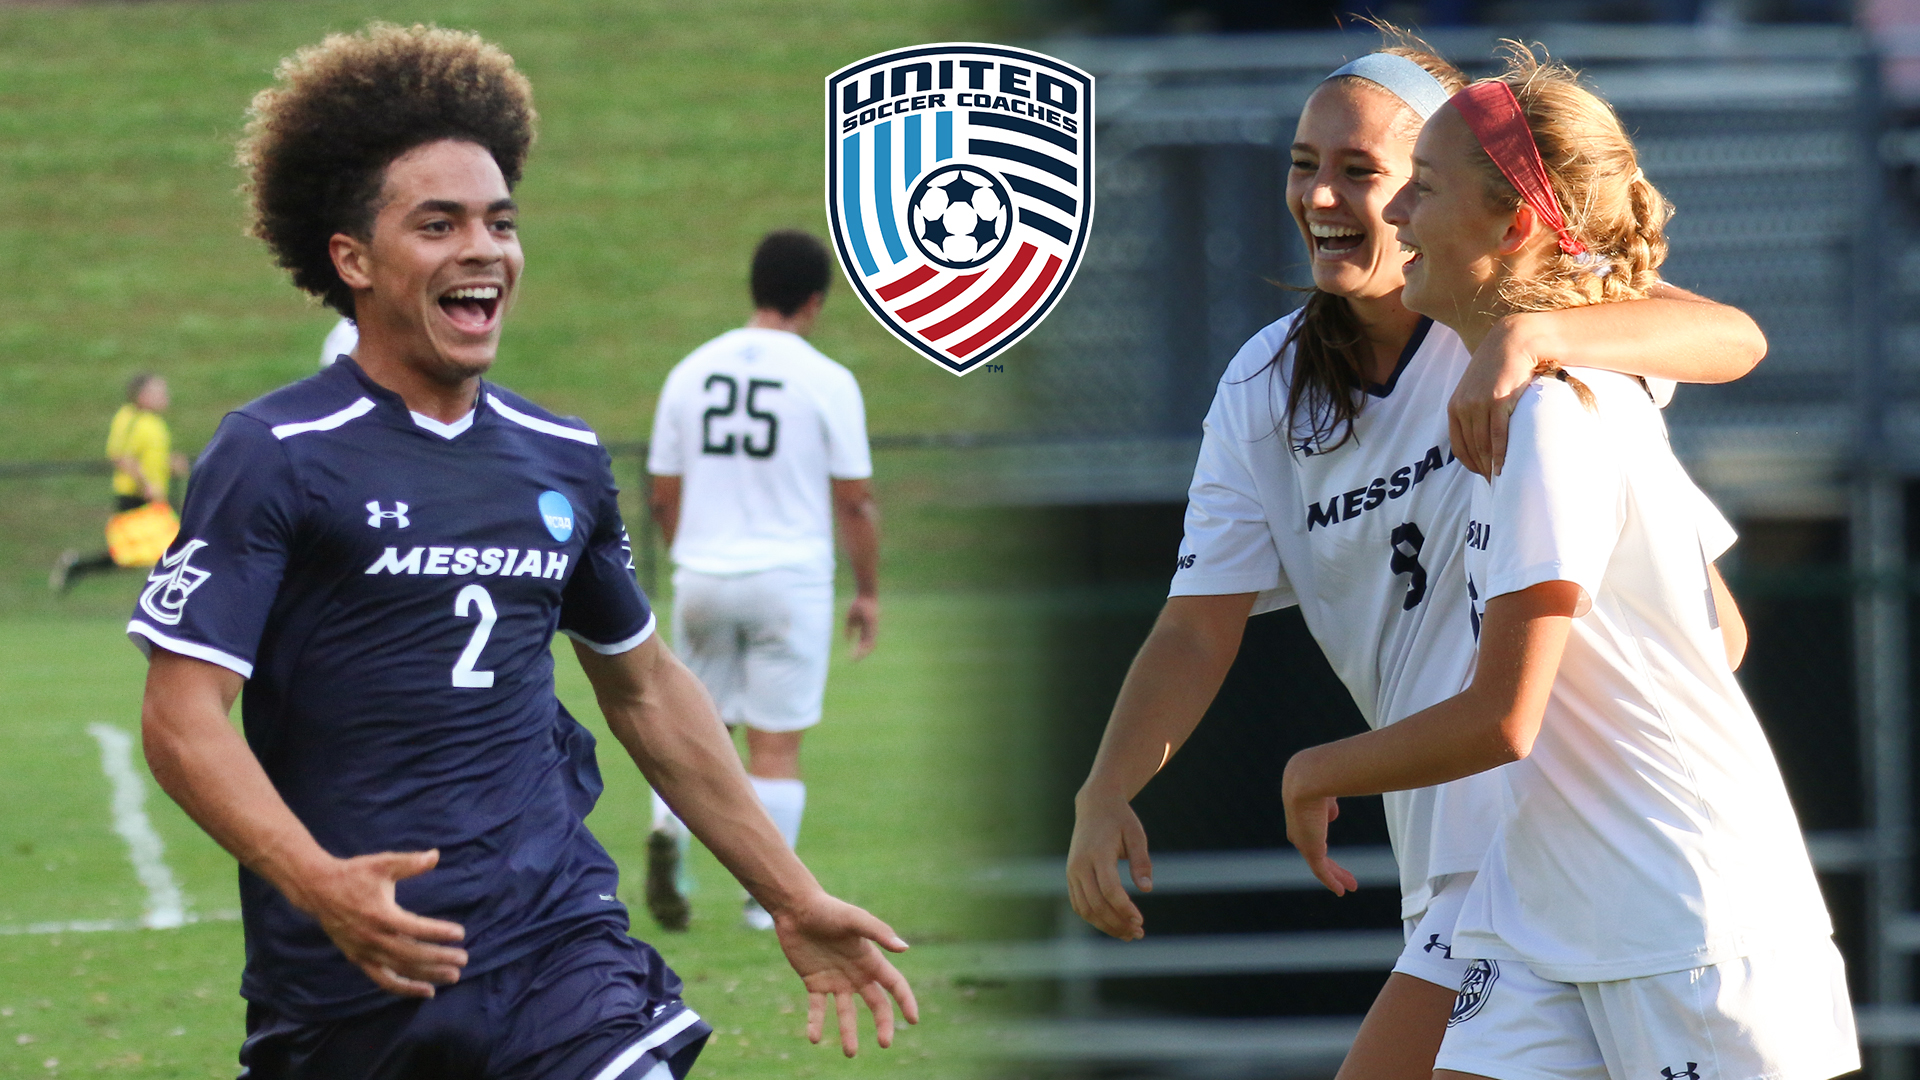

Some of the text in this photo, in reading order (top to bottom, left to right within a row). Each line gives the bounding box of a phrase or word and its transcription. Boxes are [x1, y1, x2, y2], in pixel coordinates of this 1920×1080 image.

[703, 374, 783, 459] 25
[544, 513, 573, 531] NCAA
[364, 546, 570, 581] MESSIAH
[451, 584, 498, 689] 2
